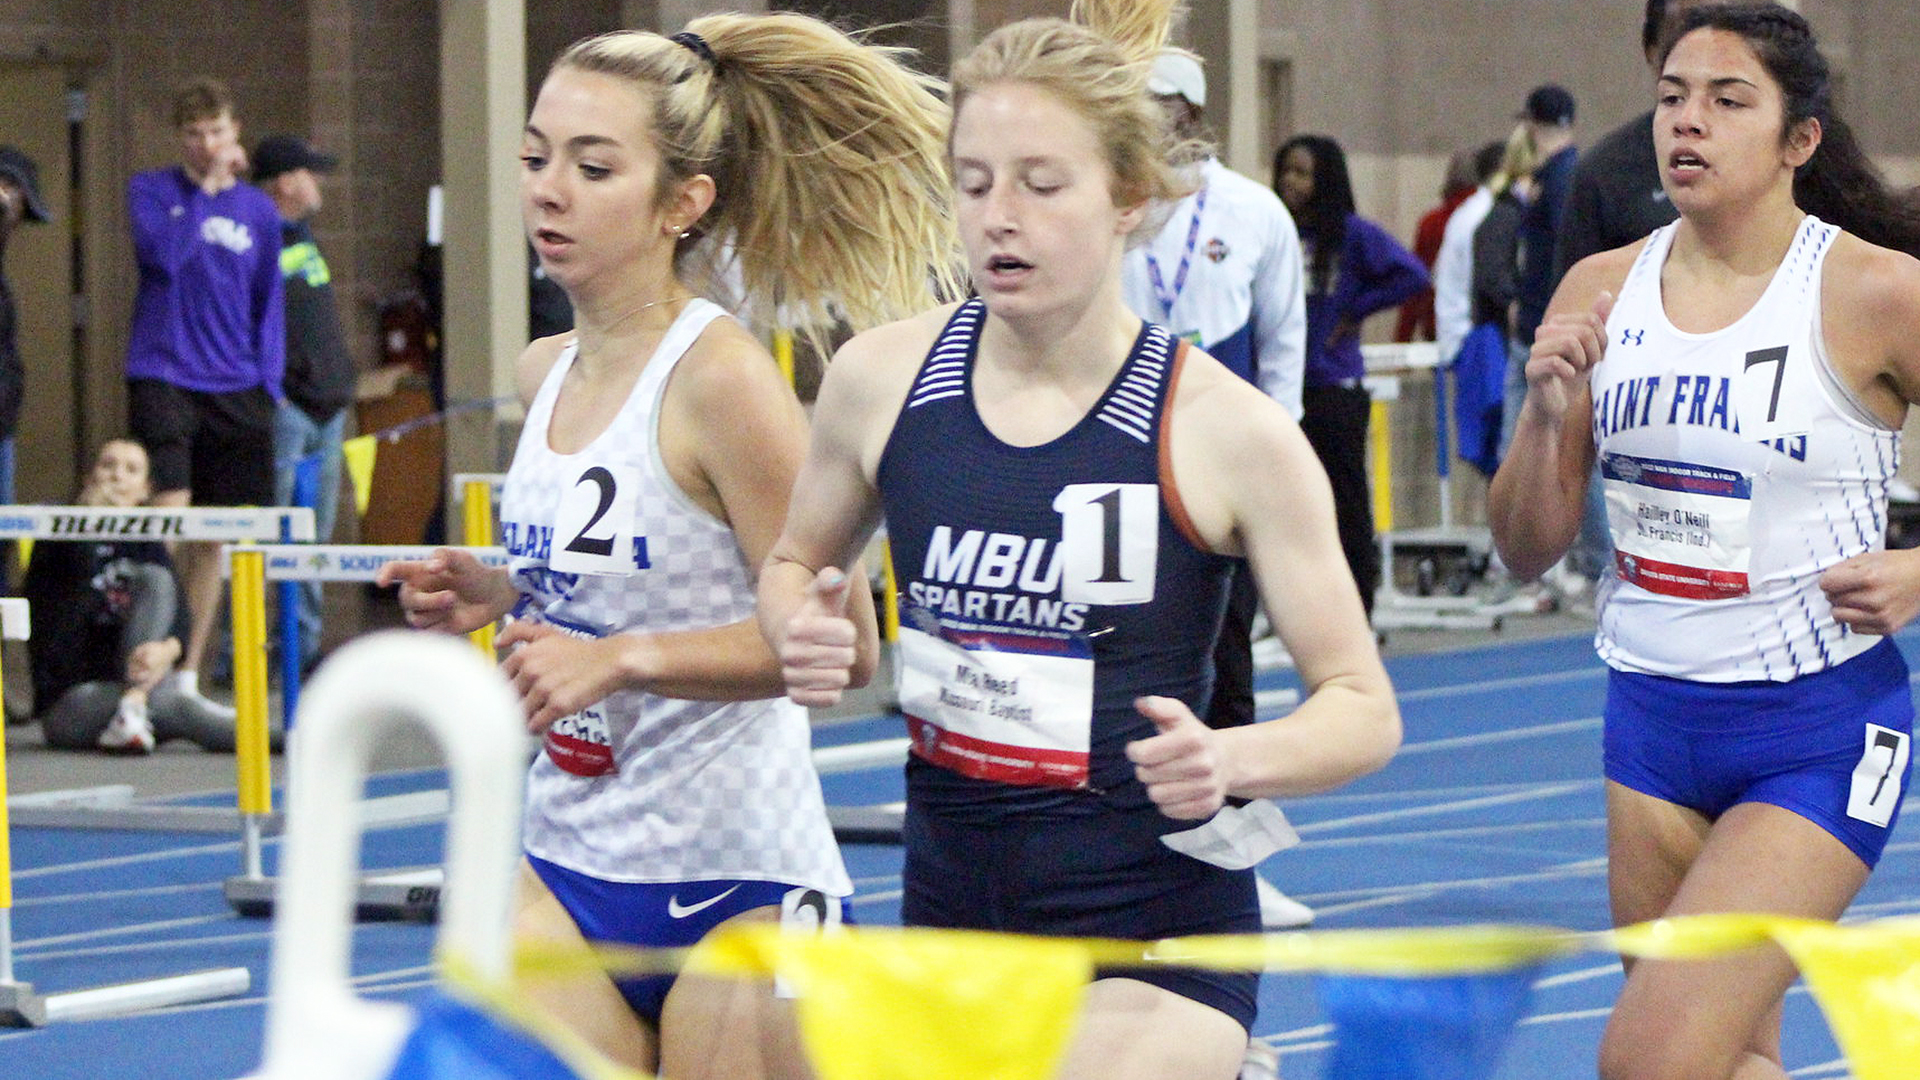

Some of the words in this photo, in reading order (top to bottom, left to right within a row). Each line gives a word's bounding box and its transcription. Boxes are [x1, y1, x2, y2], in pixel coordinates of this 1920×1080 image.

[1743, 345, 1790, 422] 7
[564, 466, 617, 556] 2
[1086, 488, 1134, 583] 1
[922, 525, 1064, 594] MBU
[909, 580, 1091, 632] SPARTANS
[1869, 730, 1900, 806] 7
